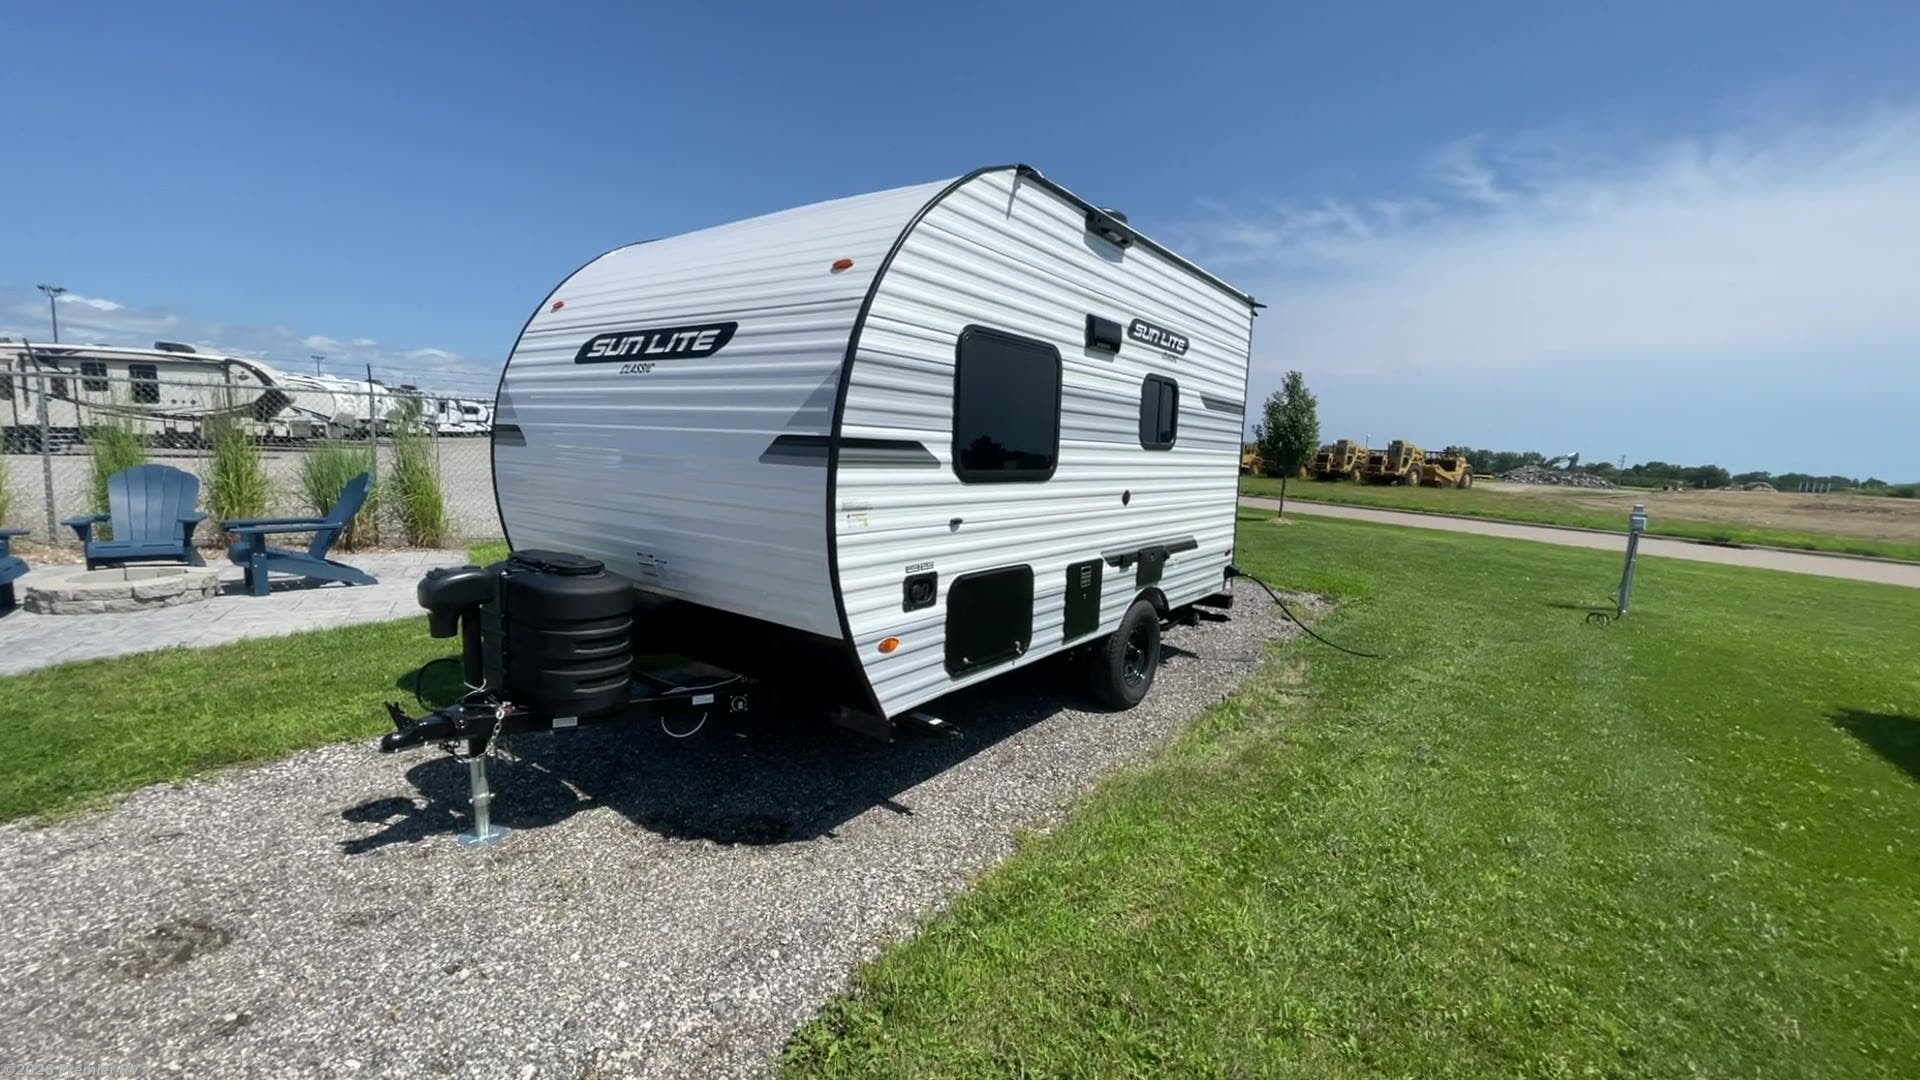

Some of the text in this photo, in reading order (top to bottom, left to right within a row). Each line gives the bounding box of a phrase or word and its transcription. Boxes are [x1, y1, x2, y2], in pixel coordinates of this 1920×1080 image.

[645, 329, 721, 354] LITE
[1160, 332, 1186, 352] LITE
[619, 363, 655, 374] CLASSIC
